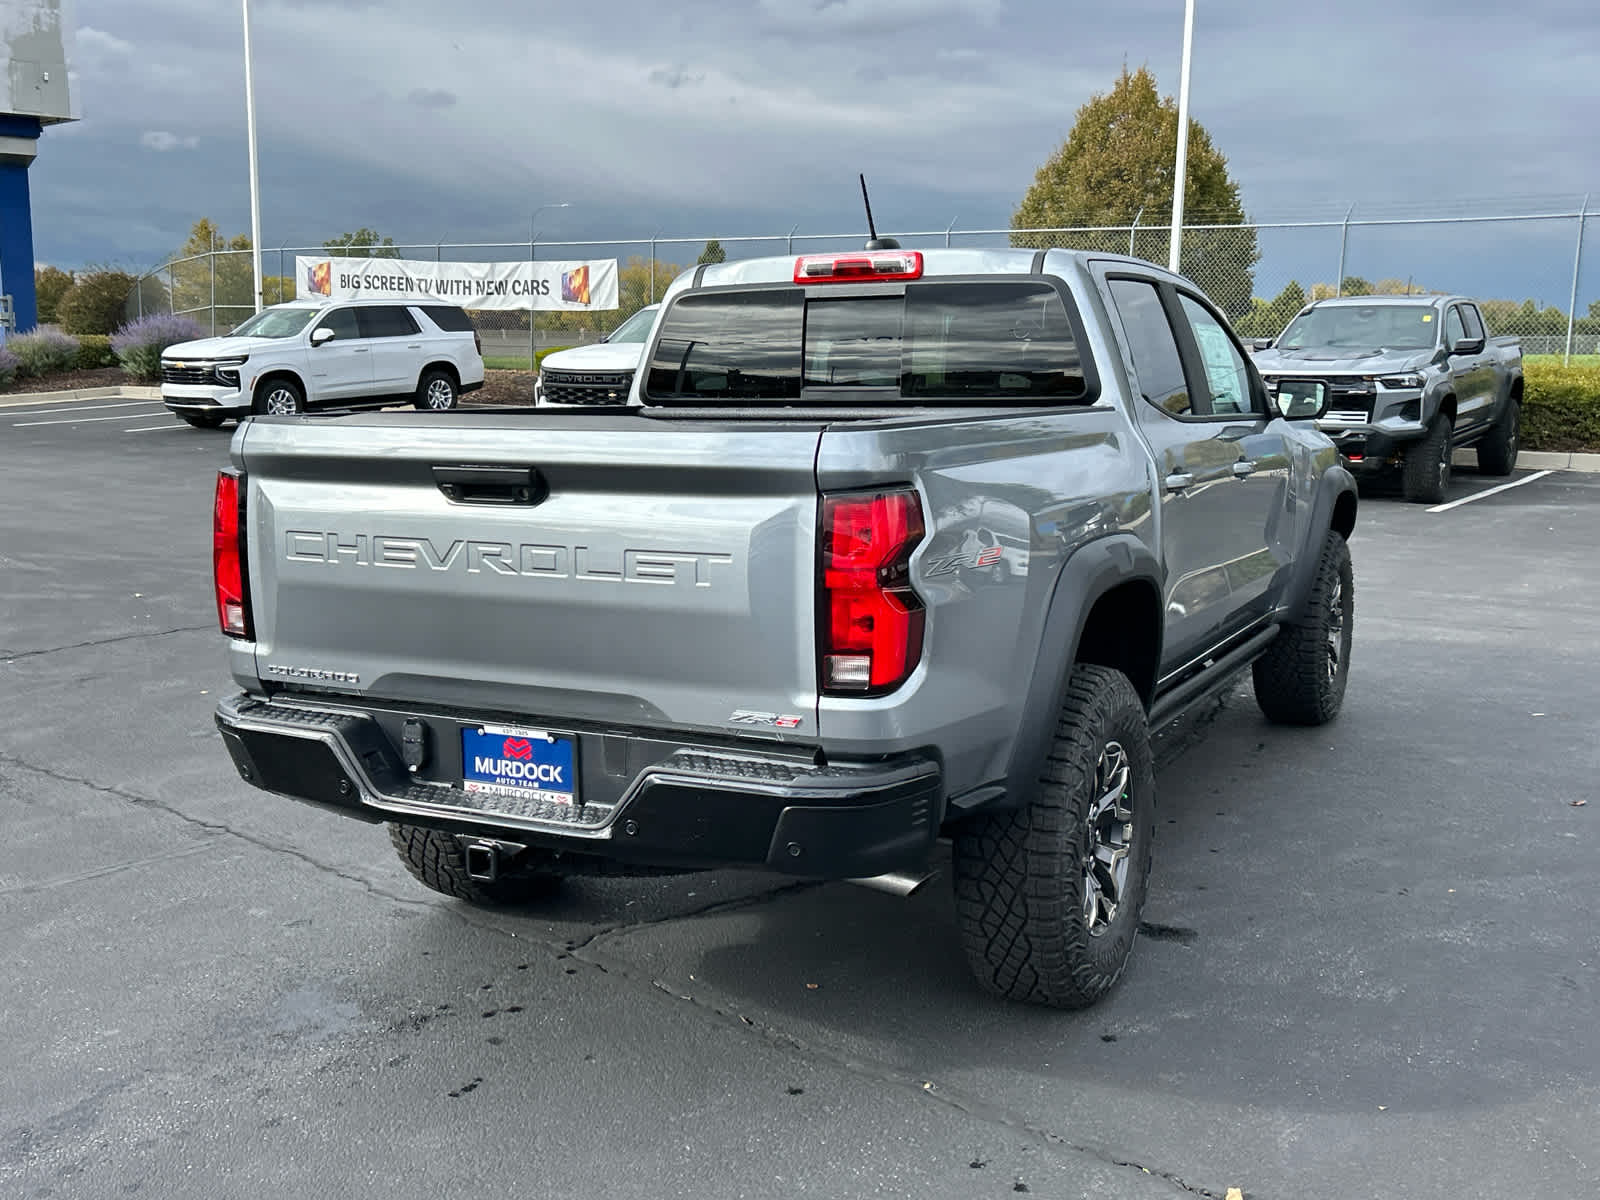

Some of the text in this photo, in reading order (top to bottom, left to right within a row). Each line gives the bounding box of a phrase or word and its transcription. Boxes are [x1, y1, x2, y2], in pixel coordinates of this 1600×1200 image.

[340, 273, 550, 296] BIG SCREEN TV WITH NEW CARS
[285, 529, 733, 588] CHEVROLET
[924, 546, 1002, 579] ZR2
[268, 664, 360, 683] COLORADO
[474, 756, 563, 783] MURDOCK
[495, 777, 539, 788] AUTO TEAM
